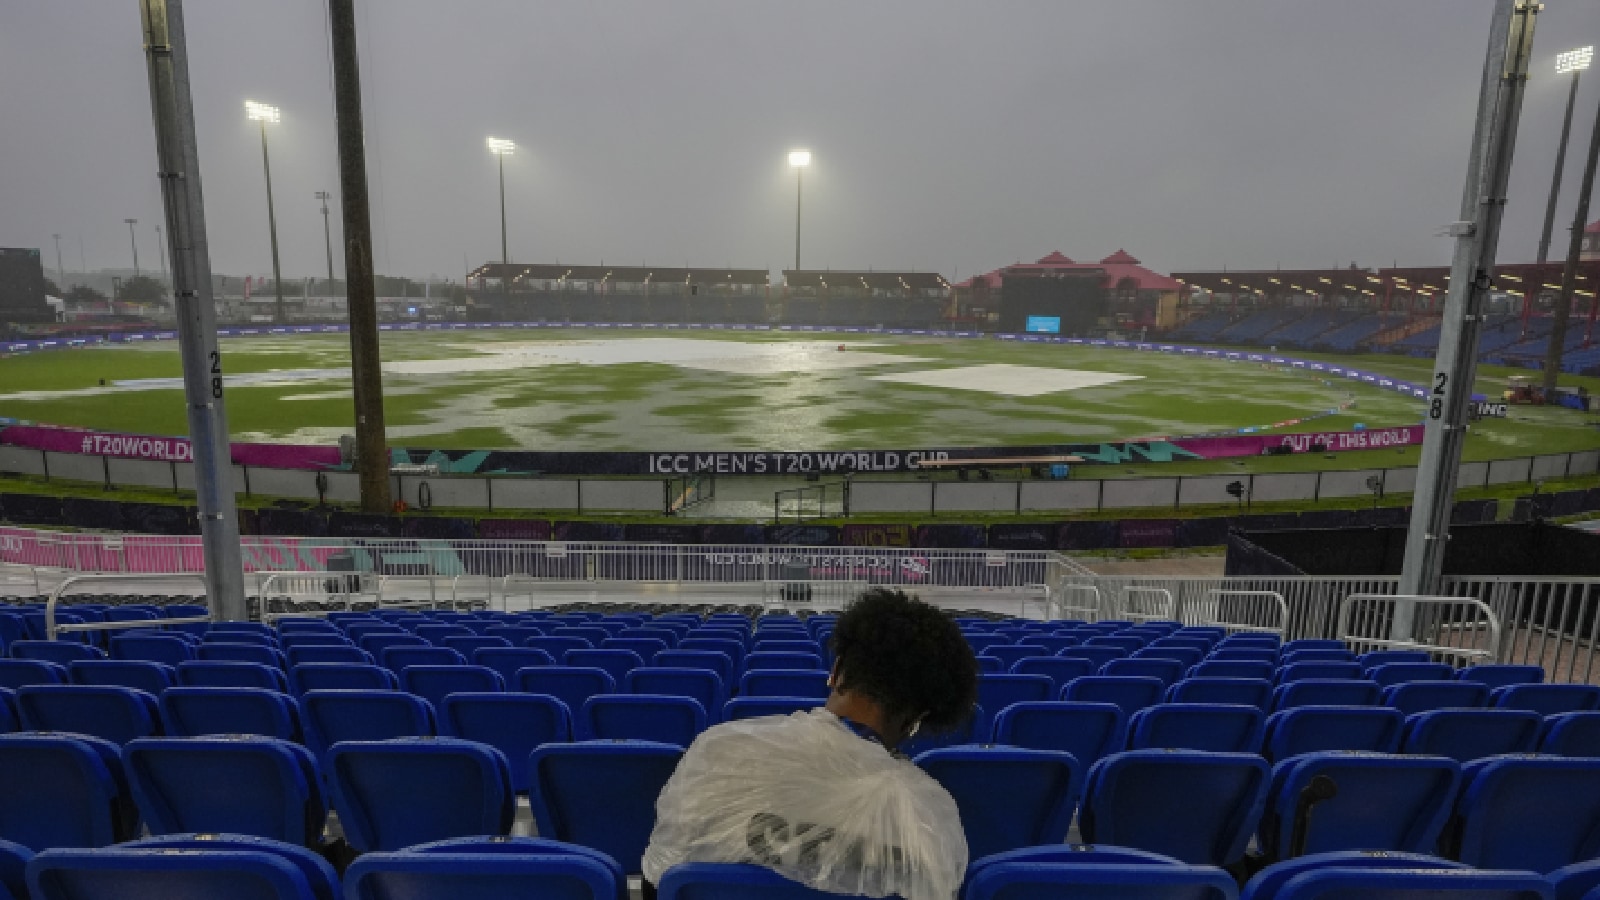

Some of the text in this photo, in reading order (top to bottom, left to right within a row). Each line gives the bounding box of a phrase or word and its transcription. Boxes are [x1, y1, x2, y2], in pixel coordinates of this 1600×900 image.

[1430, 372, 1449, 419] 28
[1281, 434, 1313, 451] OUT
[1338, 431, 1367, 448] THIS
[1369, 428, 1410, 446] WORLD
[649, 451, 949, 473] ICC MEN'S T20 WORLD CUP
